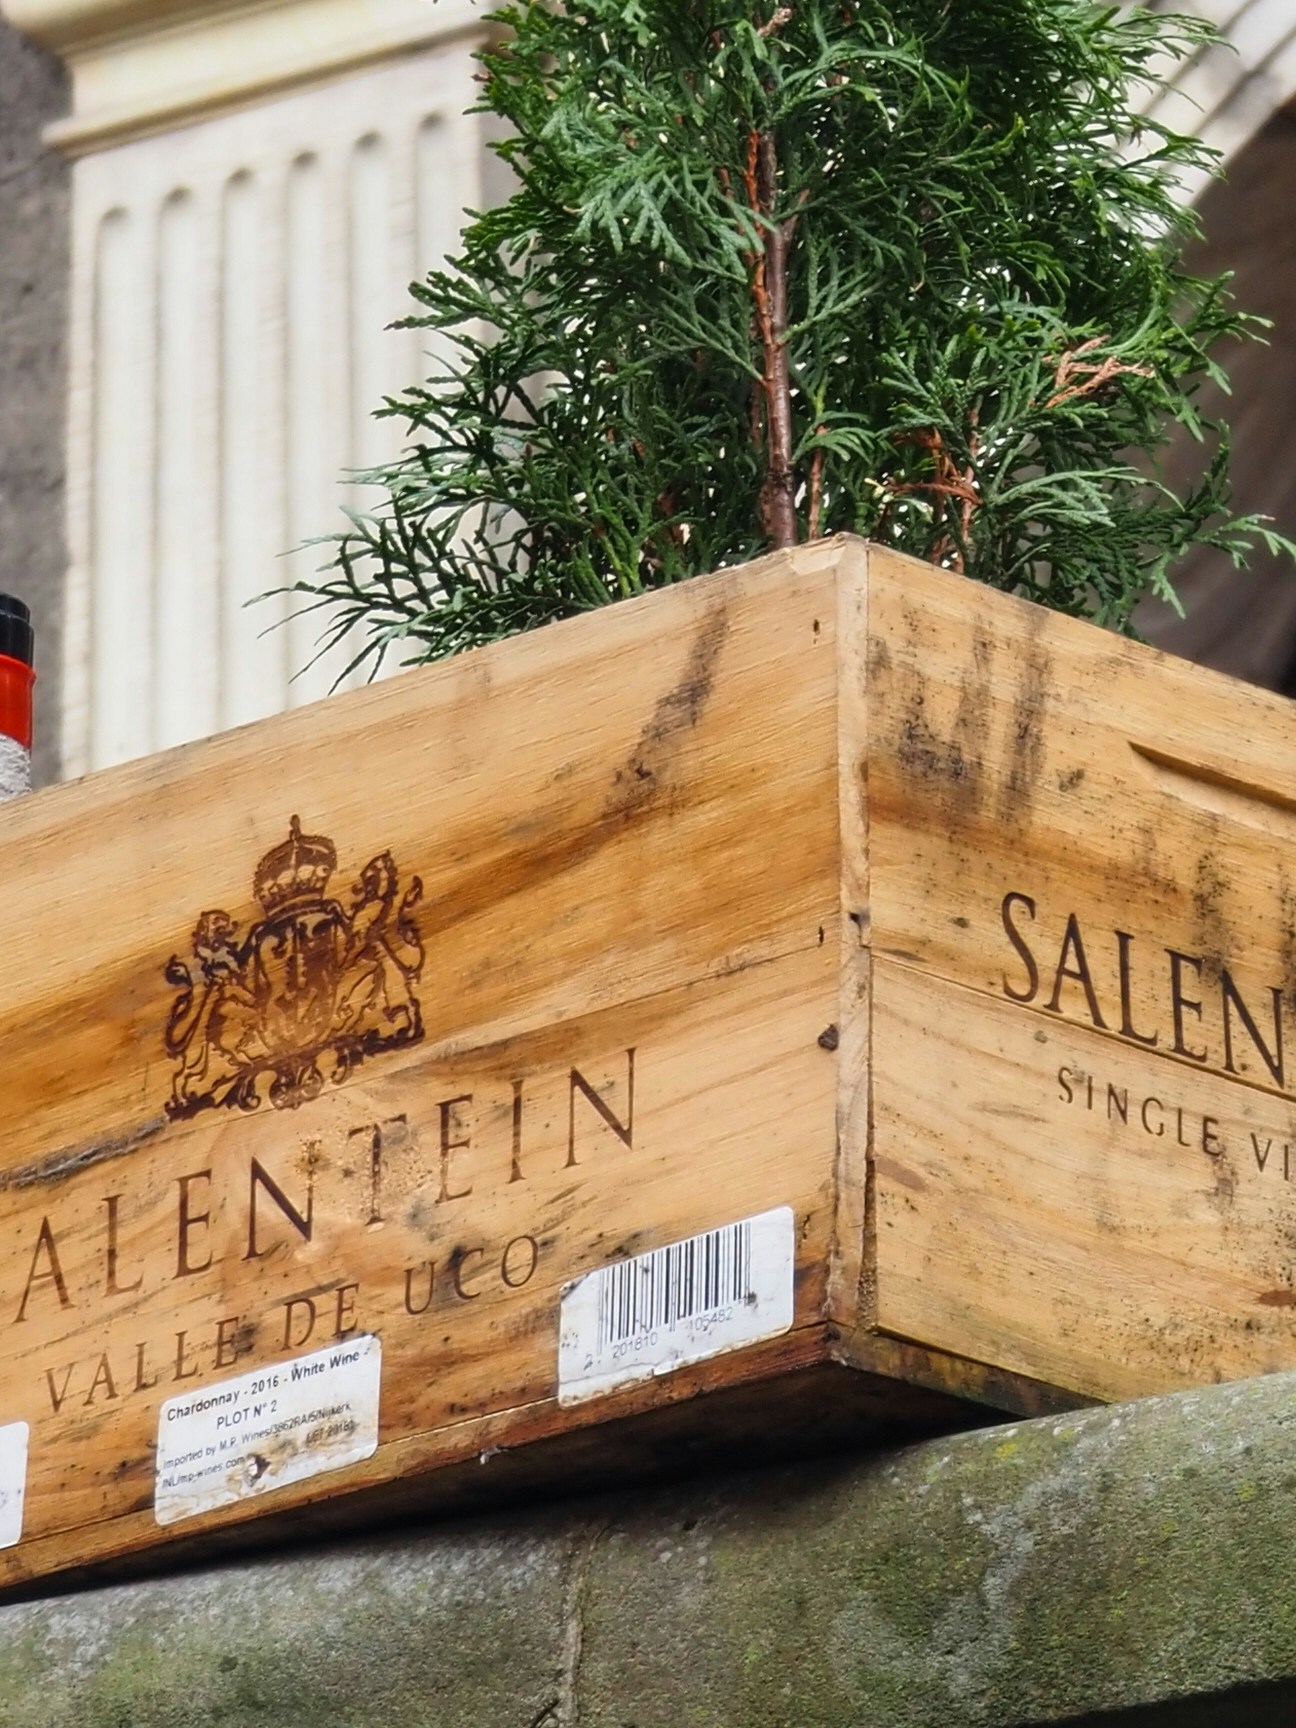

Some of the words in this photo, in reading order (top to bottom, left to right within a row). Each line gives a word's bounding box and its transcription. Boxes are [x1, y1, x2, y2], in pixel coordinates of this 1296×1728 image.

[1057, 1066, 1222, 1156] SINGLE
[44, 1315, 242, 1413] VALLE
[281, 1282, 361, 1350] DE
[403, 1234, 540, 1316] UCO
[613, 1331, 658, 1359] 201810
[688, 1307, 734, 1334] 105482
[167, 1388, 241, 1421] Chardonnay
[251, 1375, 280, 1395] 2016
[290, 1363, 325, 1382] White
[329, 1352, 361, 1370] Wine
[216, 1408, 251, 1430] PLOT
[270, 1399, 278, 1413] 2
[205, 1446, 217, 1457] by
